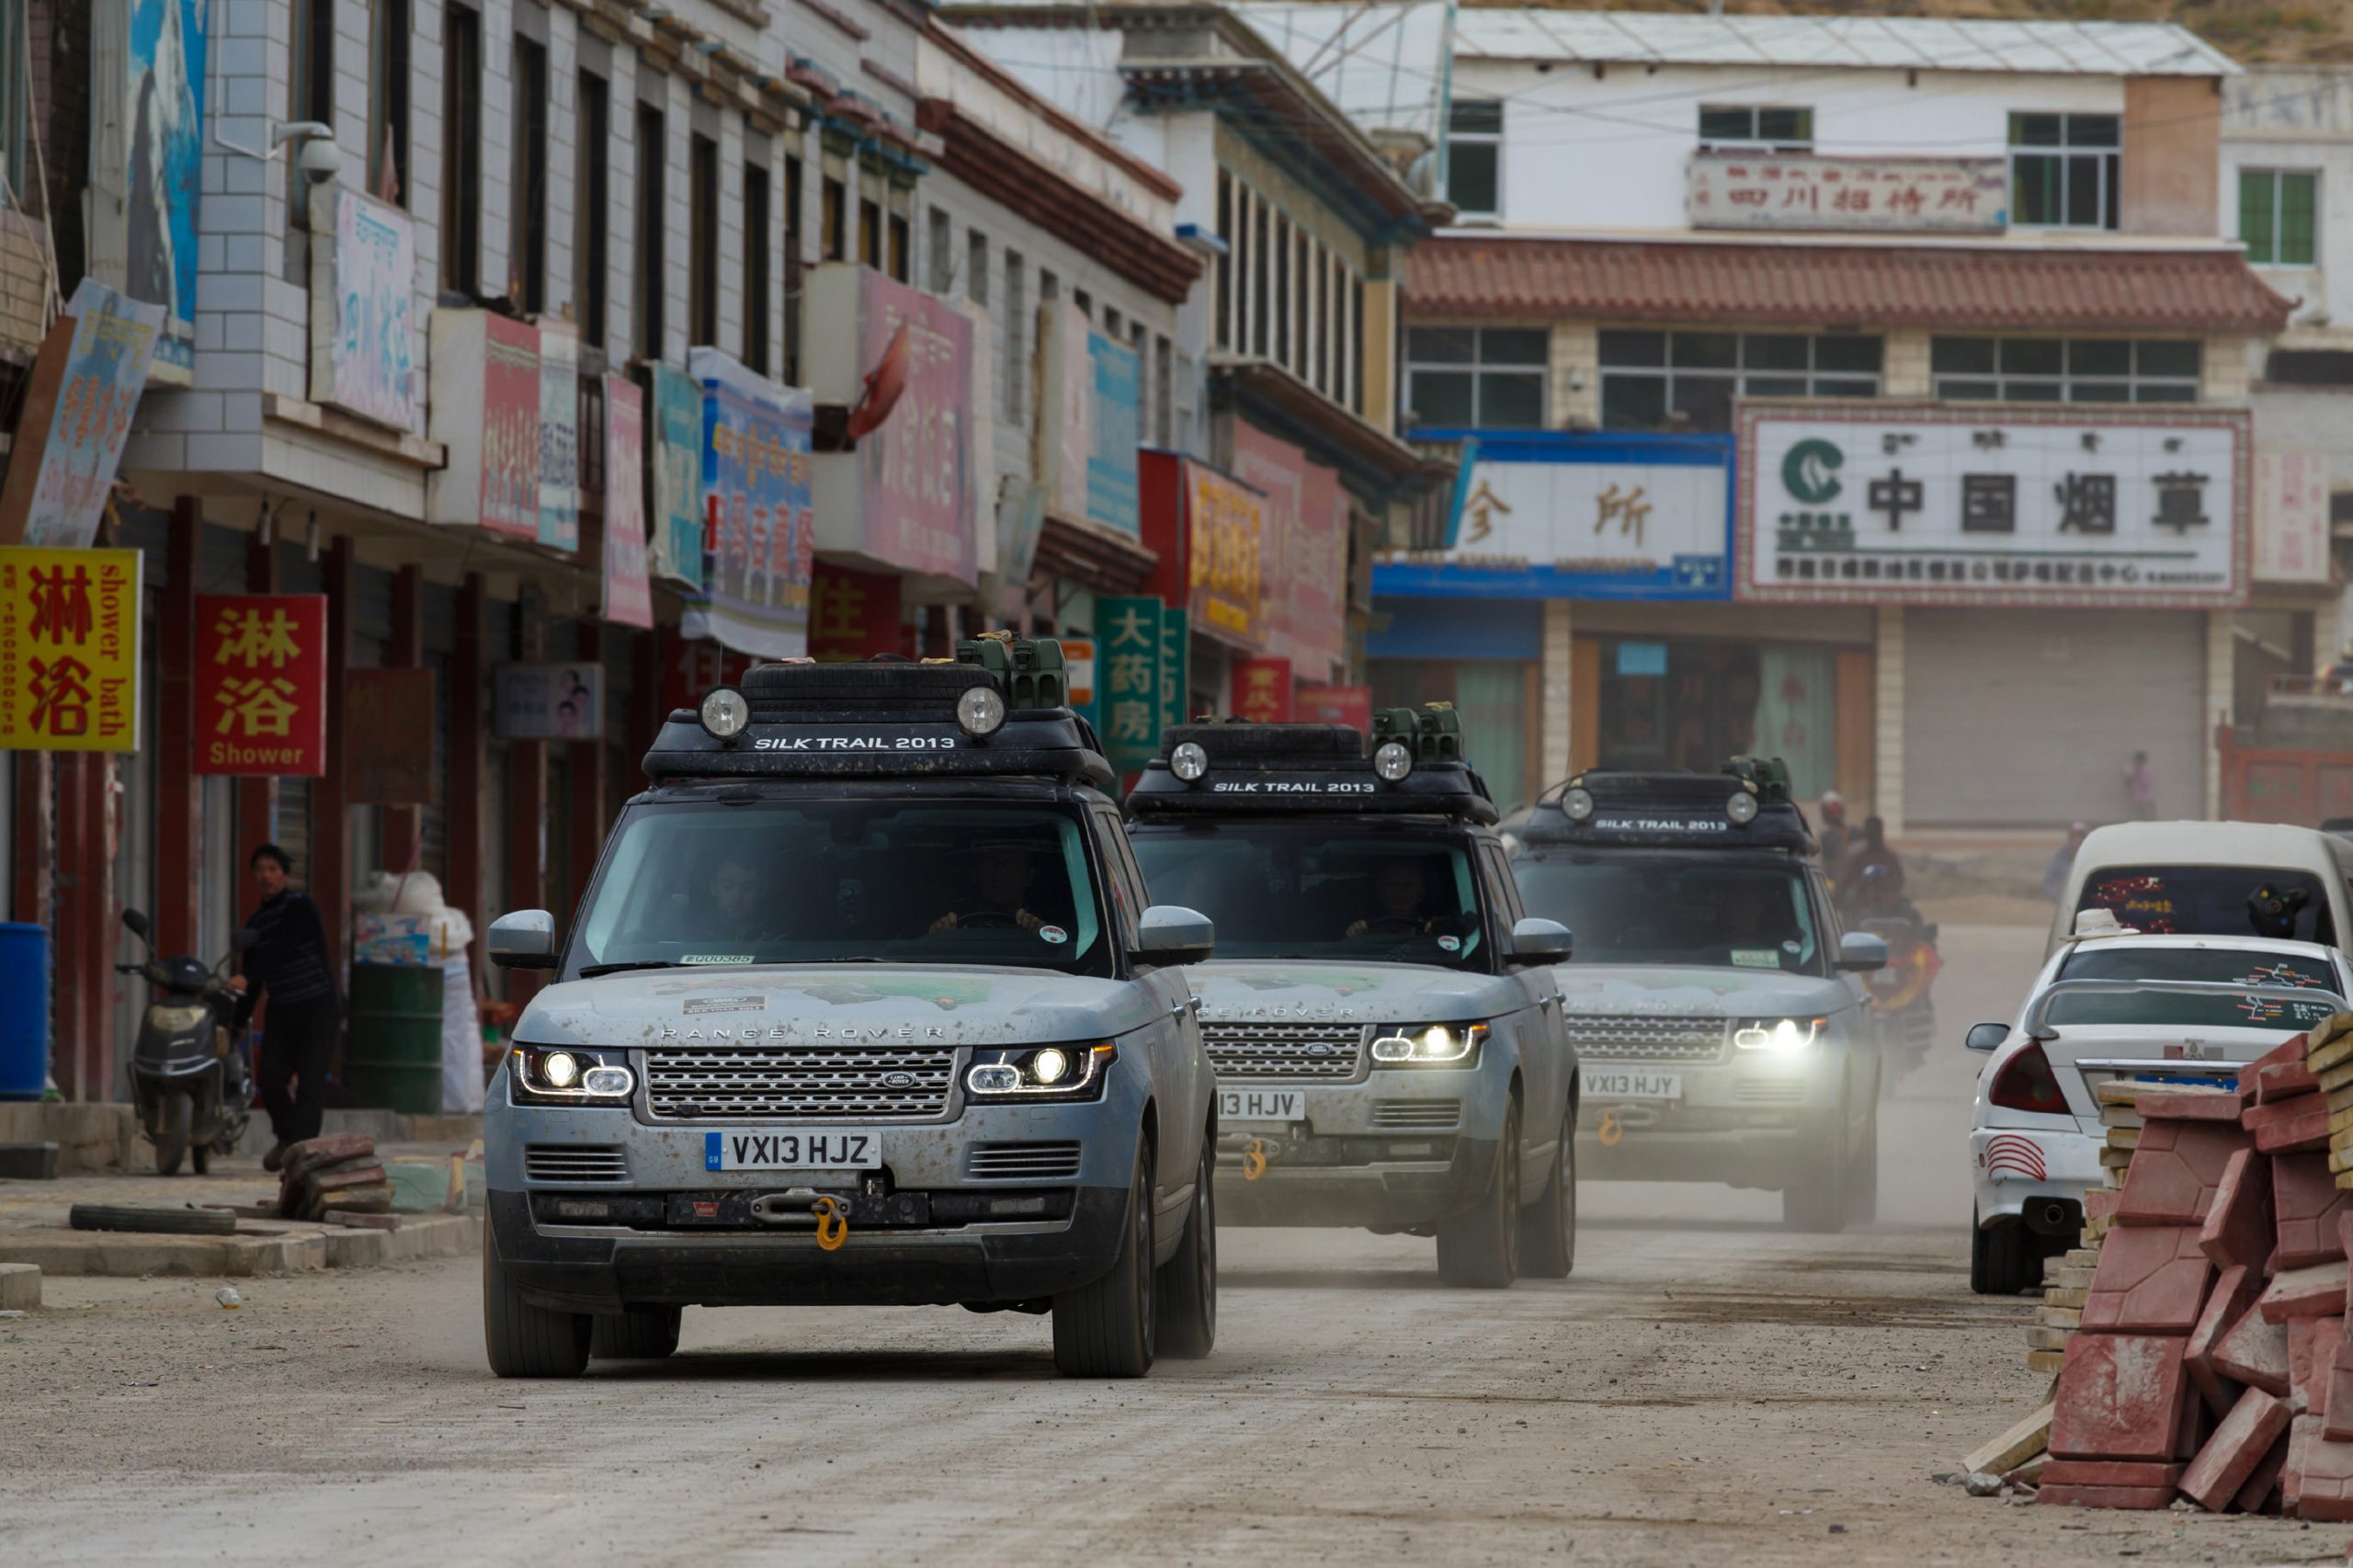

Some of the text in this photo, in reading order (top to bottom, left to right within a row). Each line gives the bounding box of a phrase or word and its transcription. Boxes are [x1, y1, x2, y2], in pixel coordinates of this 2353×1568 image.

[1727, 183, 1980, 216] 四川招待所
[1868, 468, 2211, 535] 中国烟草
[810, 576, 867, 662] 住
[28, 563, 93, 736] 淋浴
[99, 564, 127, 736] shower bath
[213, 608, 301, 736] 淋浴
[1108, 607, 1153, 742] 大药房
[210, 741, 304, 765] Shower
[754, 737, 955, 750] SILK TRAIL 2013
[1213, 782, 1375, 792] SILK TRAIL 2013
[1595, 819, 1727, 831] SILK TRAIL 2013
[661, 1027, 944, 1040] RANGE ROVER
[1586, 1074, 1673, 1095] VX13 HJY
[1219, 1093, 1295, 1116] 13 HJV
[708, 1154, 719, 1165] GB
[733, 1135, 869, 1165] VX13 HJZ
